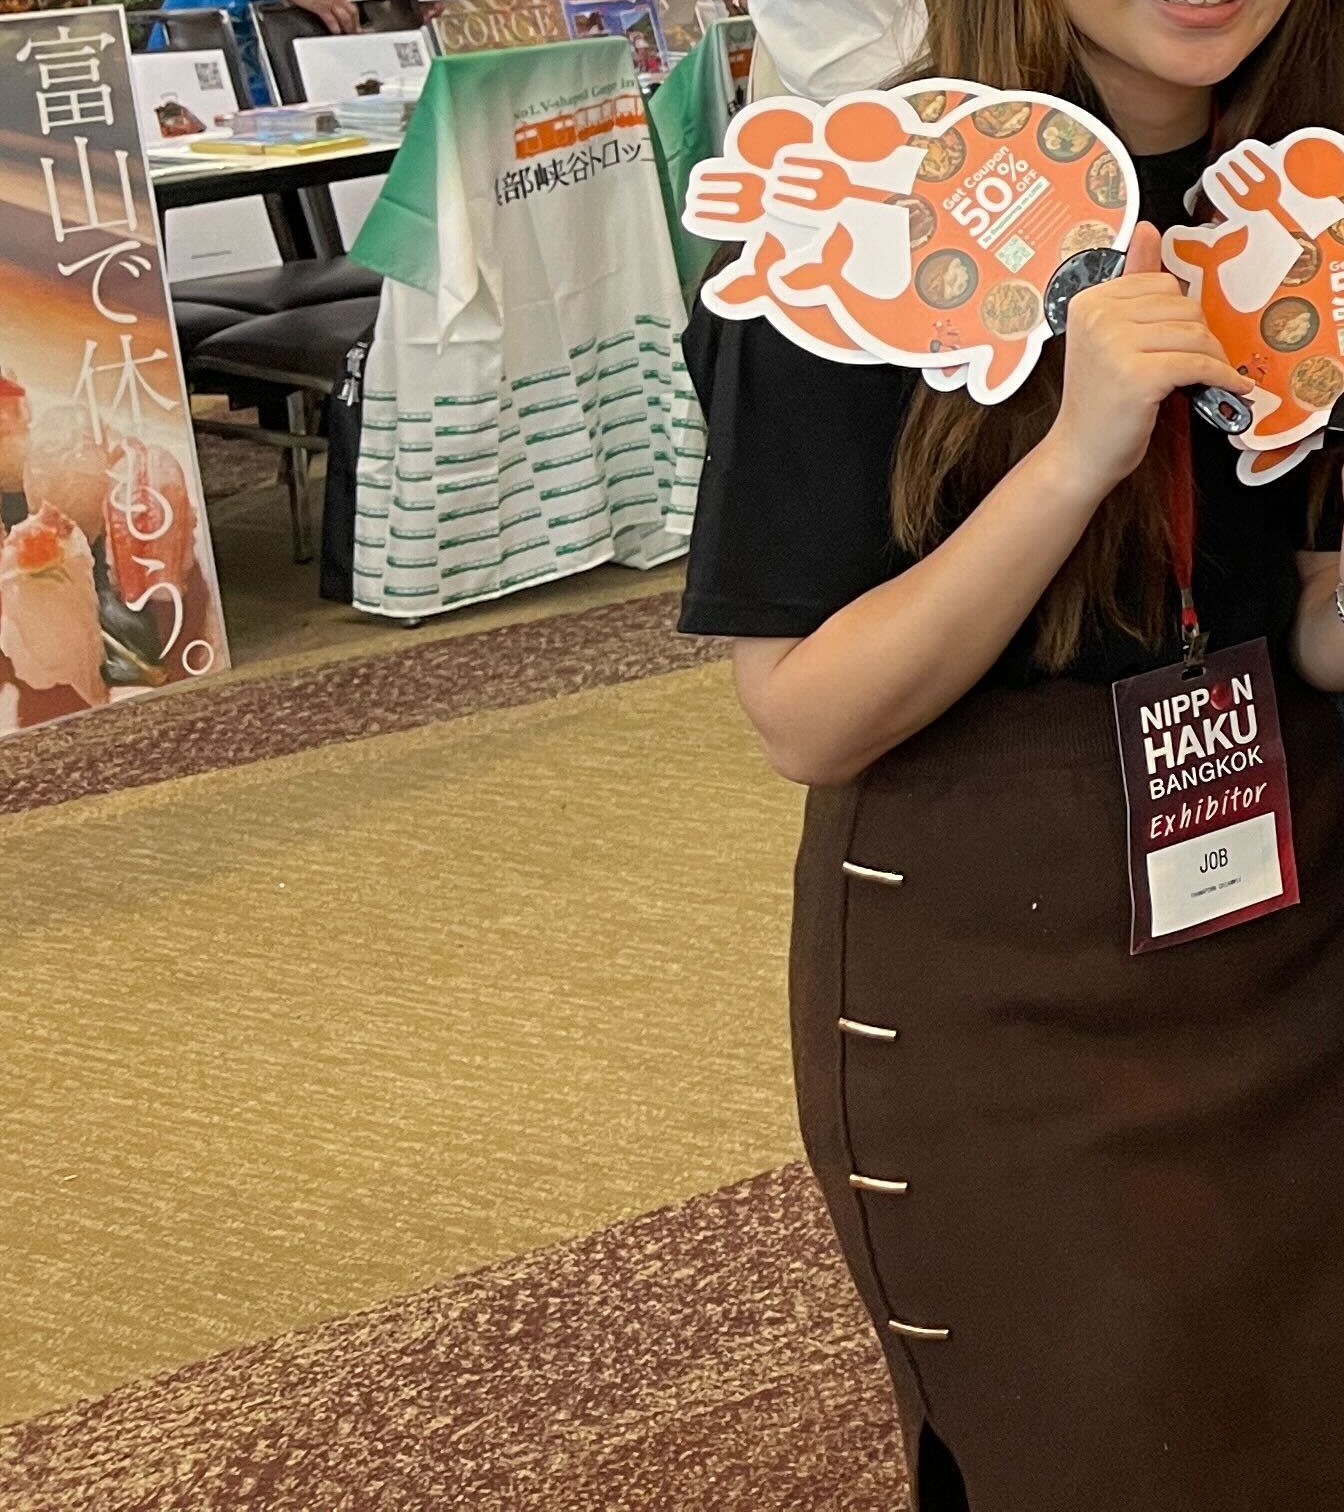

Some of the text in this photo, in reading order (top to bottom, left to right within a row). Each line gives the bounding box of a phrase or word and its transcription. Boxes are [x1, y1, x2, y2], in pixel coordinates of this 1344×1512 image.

[943, 146, 1010, 210] Get Coupon
[951, 152, 1029, 237] 50%
[1016, 169, 1038, 192] OFF
[16, 25, 214, 676] 富山で休もう。
[1143, 704, 1258, 775] HAKU
[1149, 745, 1264, 800] BANGKOK
[1150, 782, 1268, 839] Exhibitor
[1199, 847, 1229, 874] JOB
